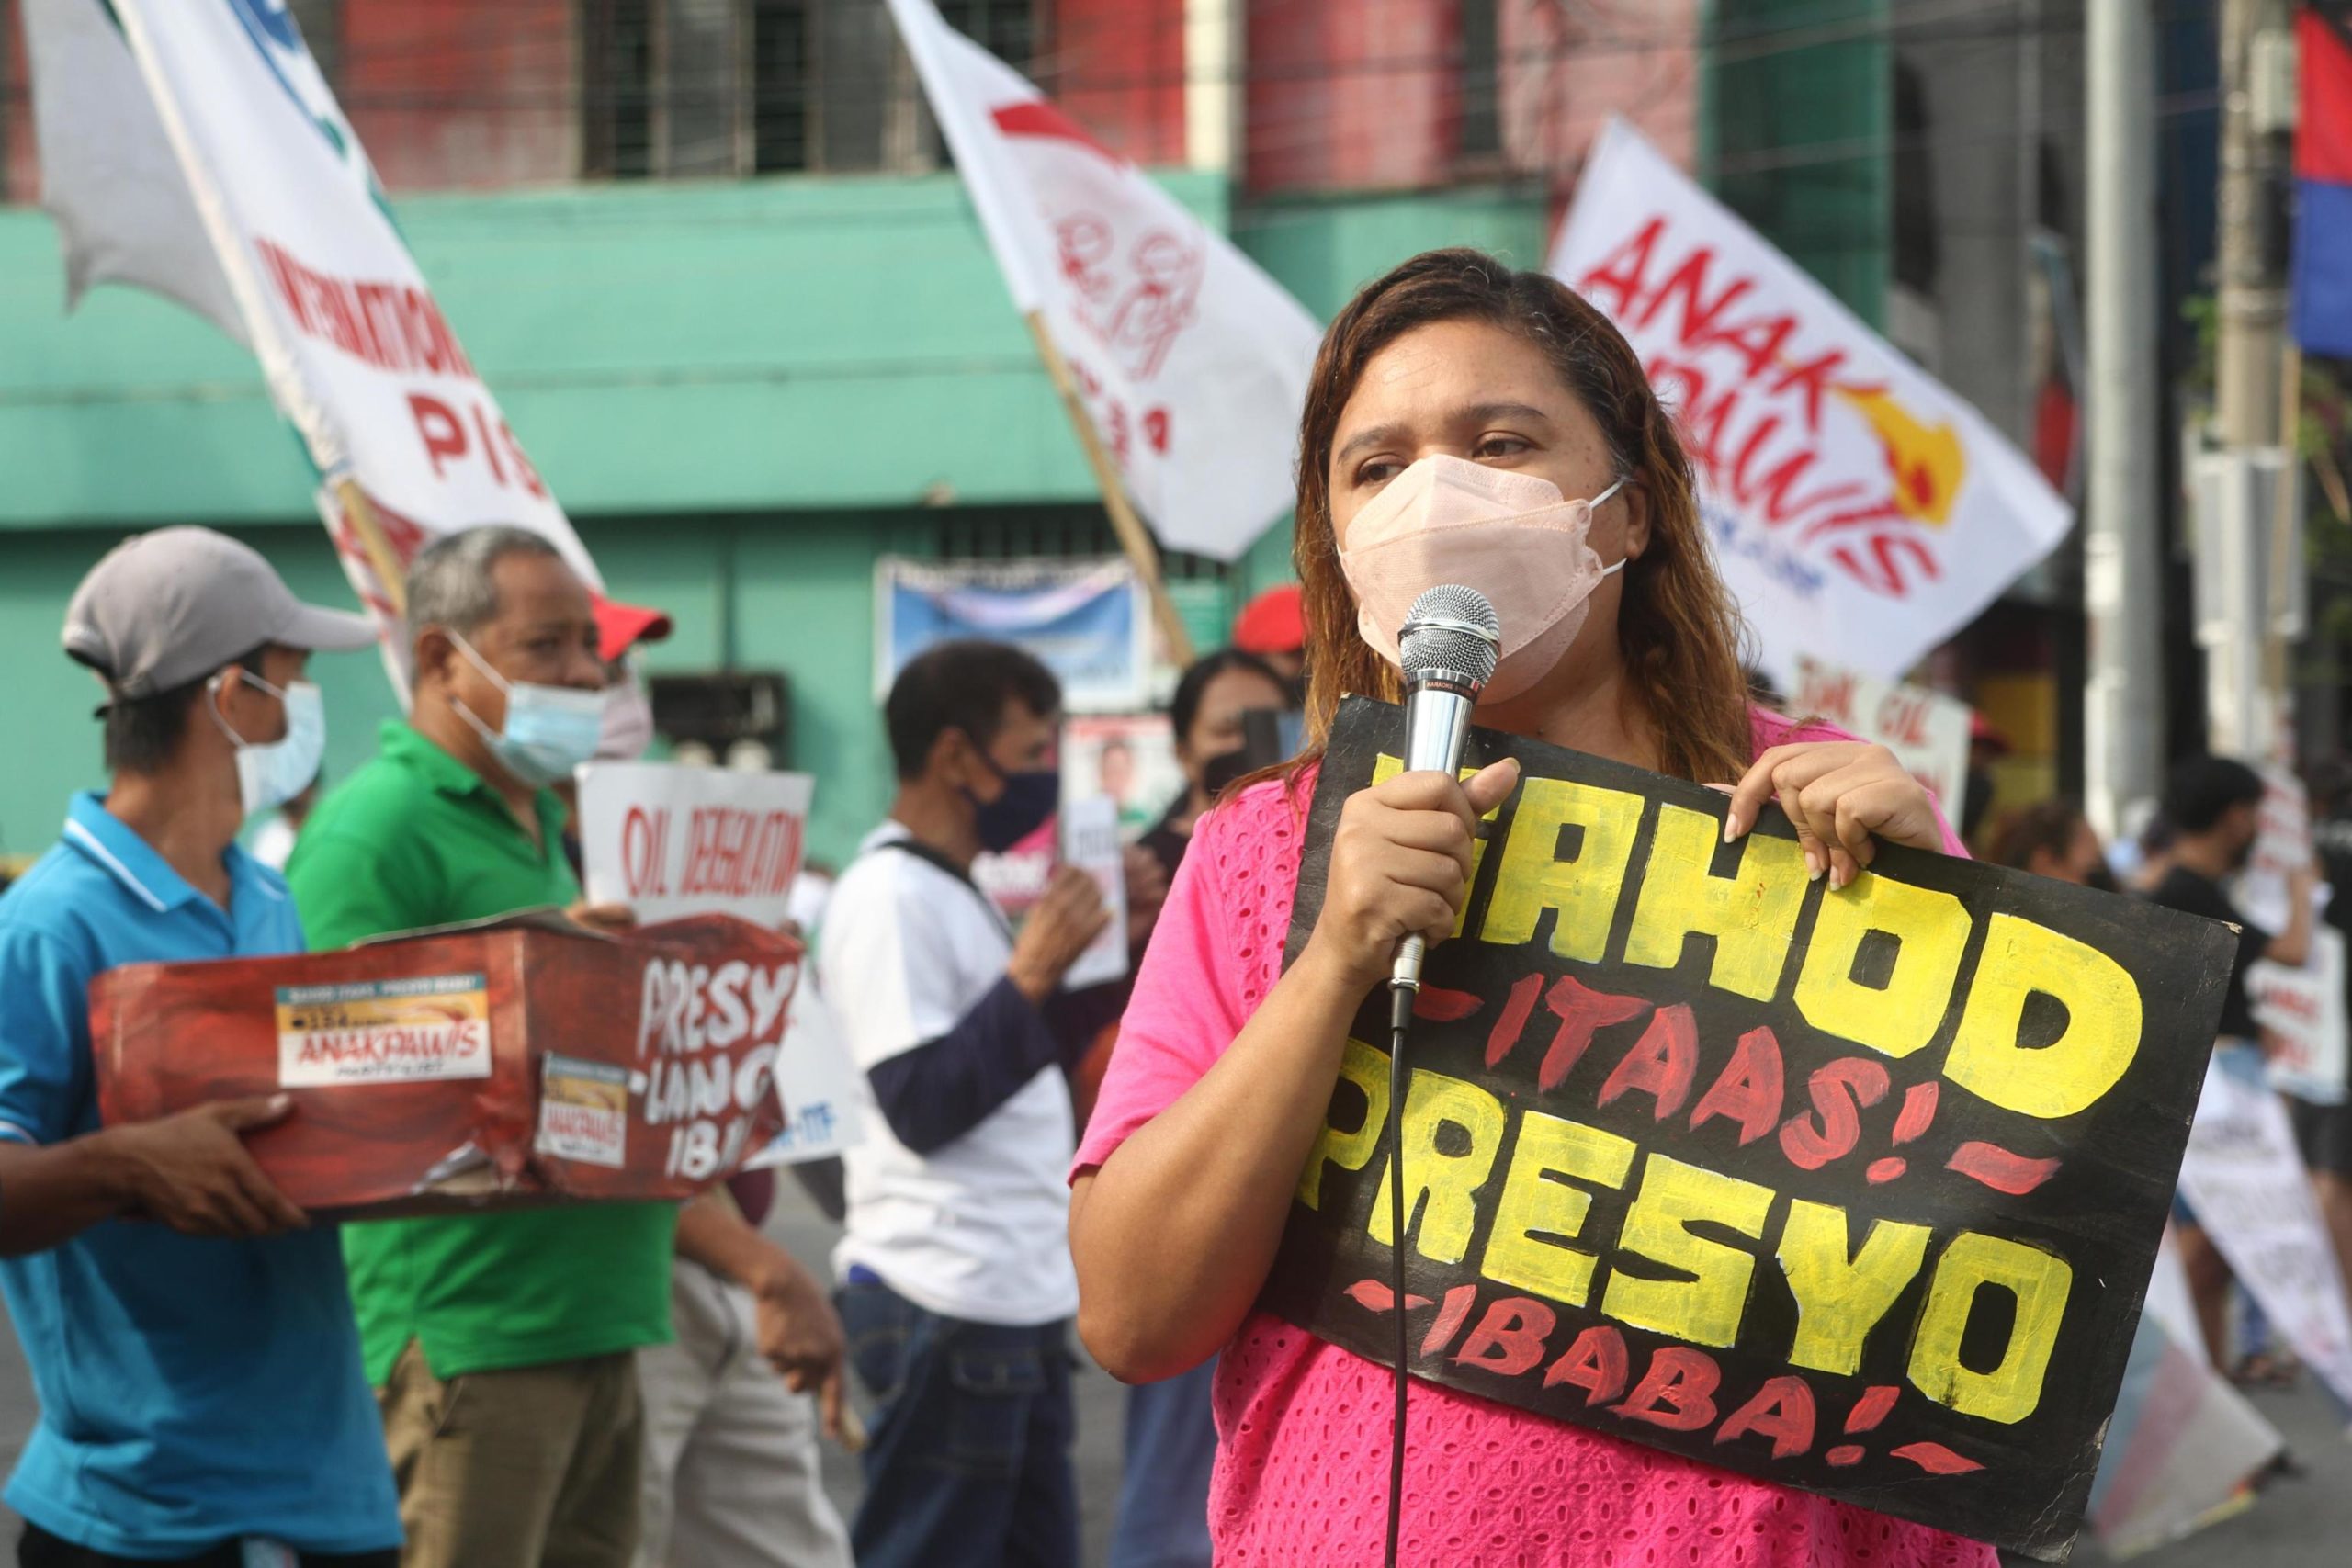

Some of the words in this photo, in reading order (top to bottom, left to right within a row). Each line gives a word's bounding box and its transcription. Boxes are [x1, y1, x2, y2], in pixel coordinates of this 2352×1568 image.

[1581, 215, 1849, 440] ANAK
[621, 804, 672, 898] OIL
[299, 1021, 481, 1065] ANAKPAWIS
[1294, 1037, 2073, 1426] PRESYO
